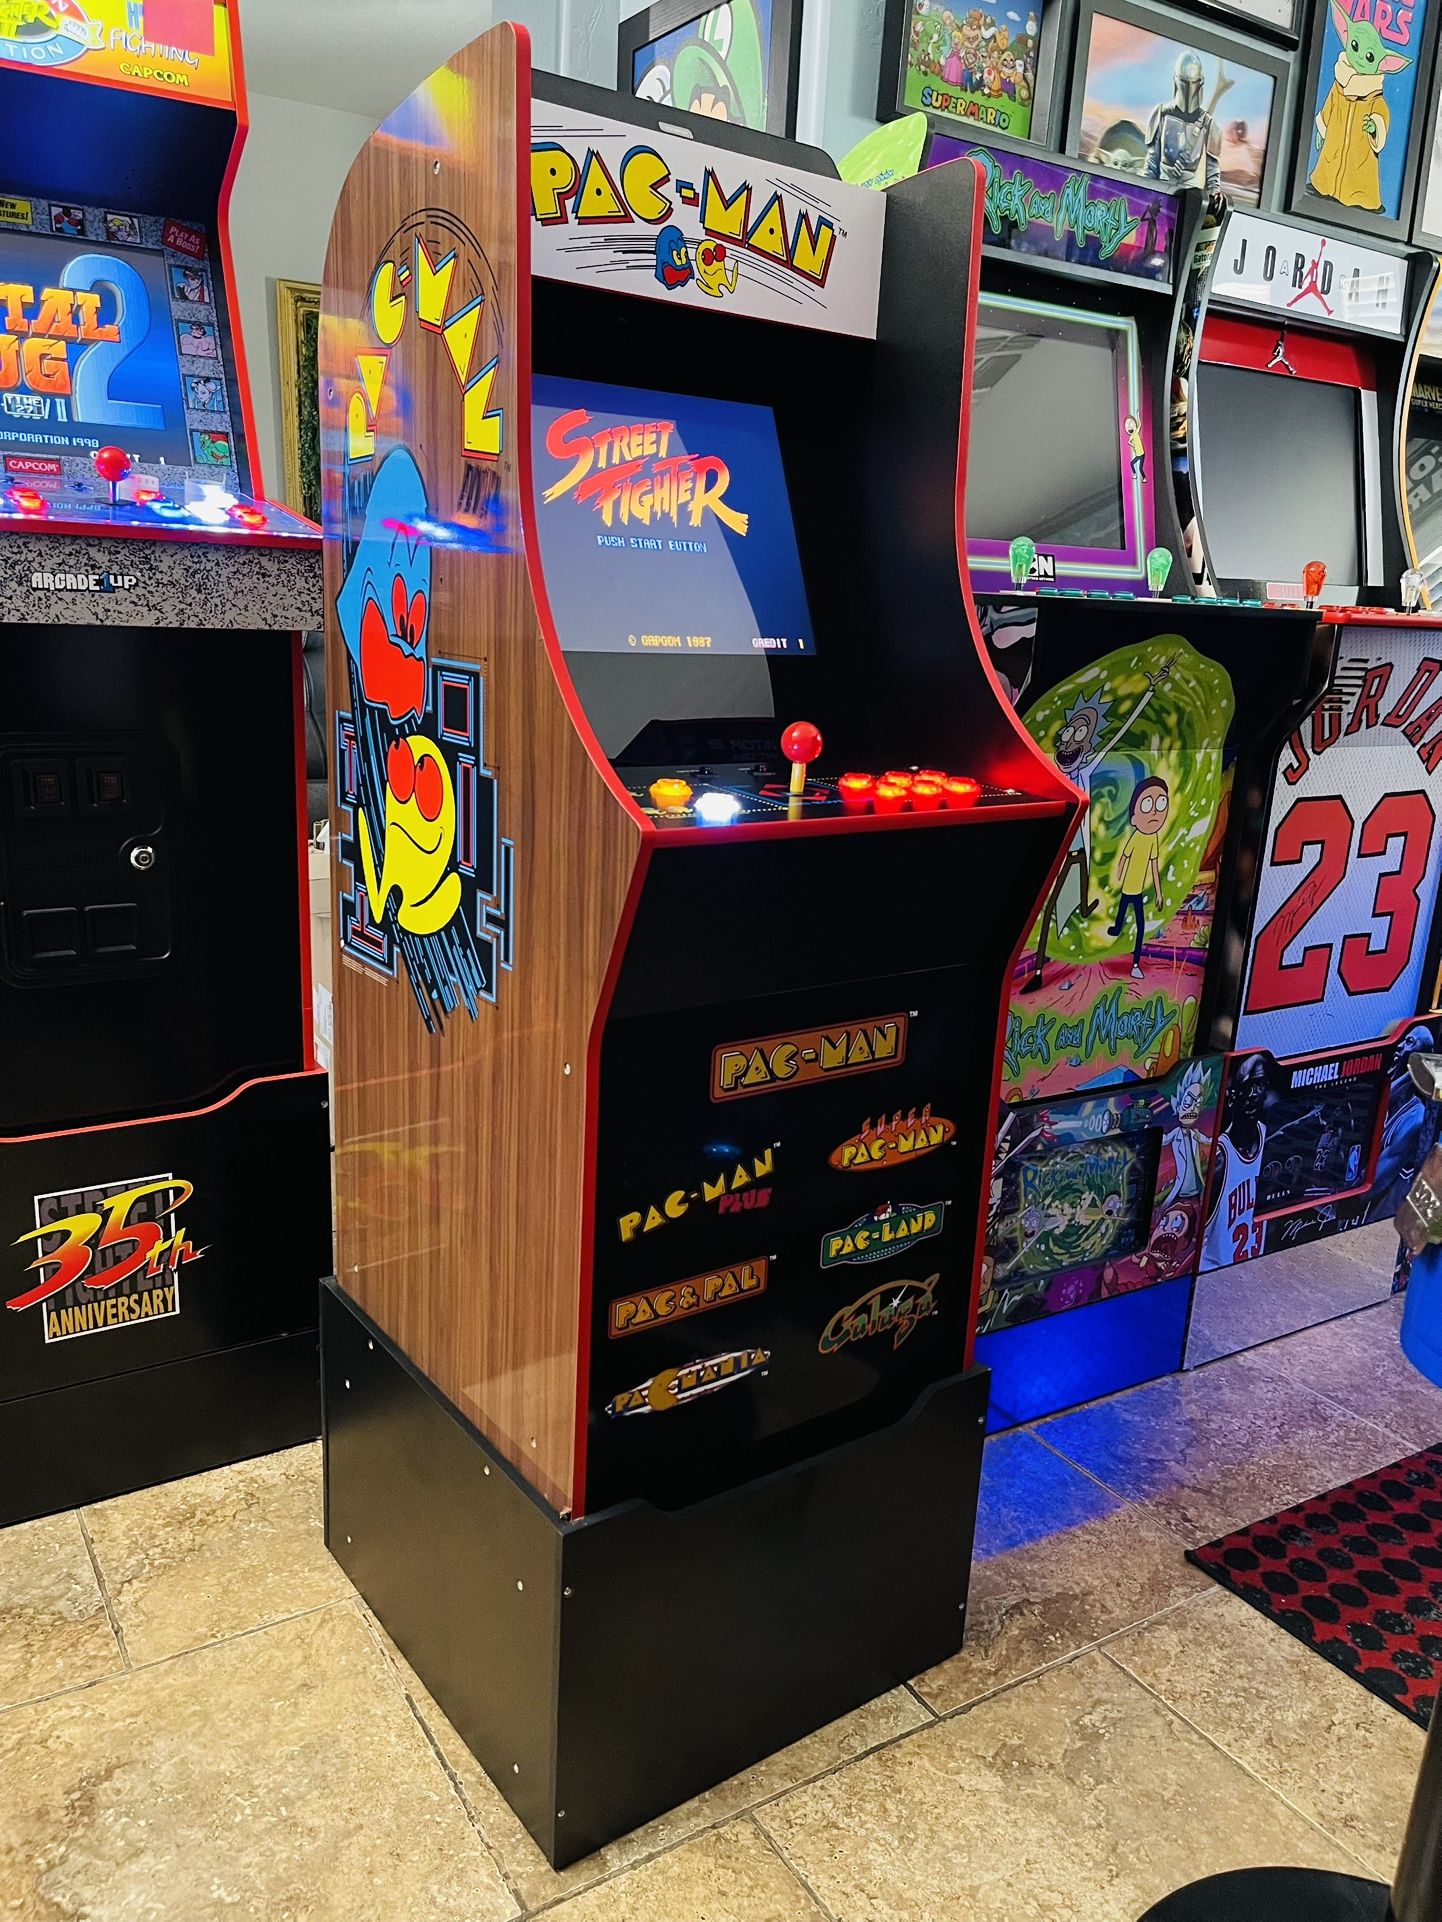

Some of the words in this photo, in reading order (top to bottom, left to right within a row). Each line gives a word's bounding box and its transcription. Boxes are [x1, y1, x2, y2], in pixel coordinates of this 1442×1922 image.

[119, 63, 190, 87] CAPCOM
[921, 86, 968, 114] SUPER
[966, 100, 1011, 130] MARIO
[531, 142, 837, 289] PAC-MAN
[1232, 238, 1391, 310] JORDAN
[0, 282, 122, 343] TAL
[59, 253, 166, 431] 2
[347, 232, 504, 466] PAC-MAN
[9, 459, 58, 473] CAPCOM
[73, 438, 100, 448] 1998
[542, 408, 674, 505] STREET
[573, 452, 750, 537] FIGHTER
[597, 535, 626, 548] PUSH
[629, 537, 663, 550] START
[641, 635, 682, 647] CAPCOM
[686, 636, 712, 648] 1987
[752, 637, 788, 649] CREDIT
[1242, 788, 1437, 1016] 23
[719, 1022, 899, 1092] PAC-MAN
[1290, 1062, 1340, 1089] MICHAEL
[1340, 1053, 1383, 1079] JORDAN
[841, 1122, 946, 1169] PAC-MAN
[860, 1102, 932, 1140] SUPER
[618, 1147, 774, 1243] PAC-MAN
[717, 1187, 773, 1217] PLUS
[829, 1210, 938, 1259] PAC-LAND
[48, 1285, 175, 1339] ANNIVERSARY
[615, 1289, 677, 1331] PAC
[679, 1284, 699, 1310] &
[703, 1264, 761, 1303] PAL
